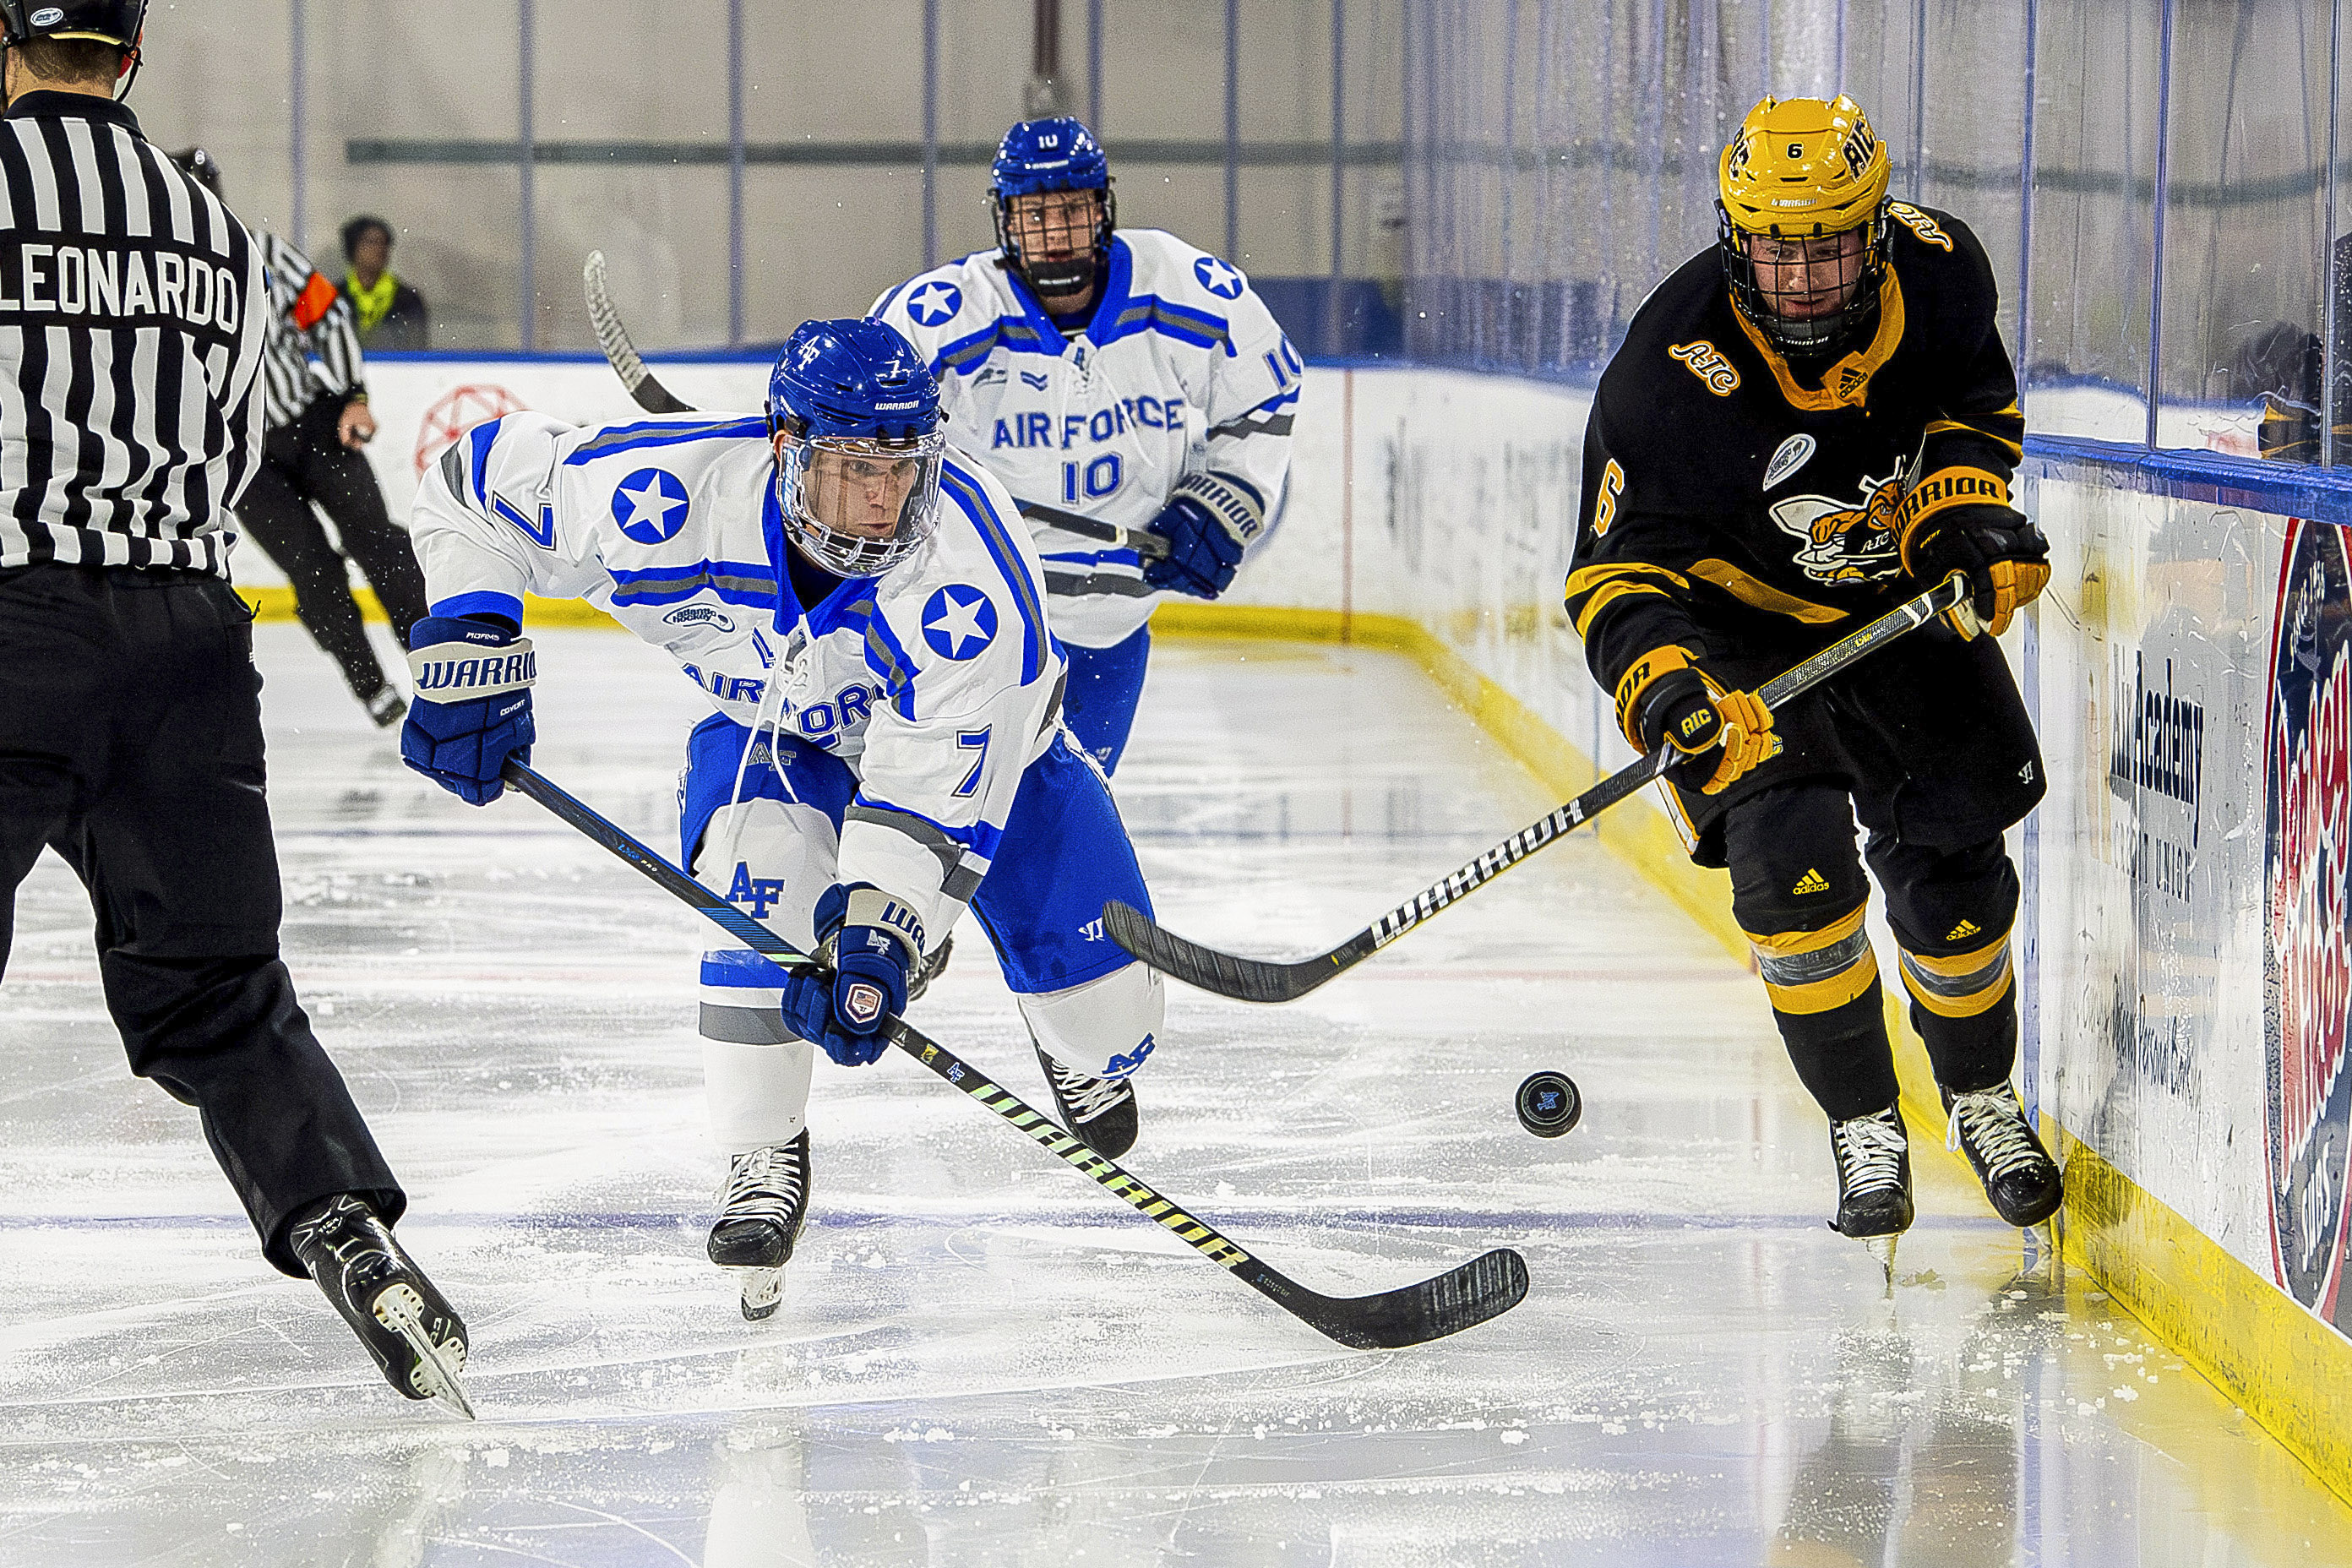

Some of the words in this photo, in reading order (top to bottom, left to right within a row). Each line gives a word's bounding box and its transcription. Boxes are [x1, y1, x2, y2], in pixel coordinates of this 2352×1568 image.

[1787, 143, 1804, 161] 6
[884, 359, 901, 378] 7
[1669, 340, 1741, 396] AIC
[874, 400, 919, 411] WARRIOR
[992, 411, 1053, 450] AIR
[1060, 394, 1184, 451] FORCE
[1061, 450, 1124, 505] 10
[1593, 457, 1625, 538] 6
[500, 700, 525, 716] COVERT
[1681, 709, 1712, 738] AIC
[950, 723, 993, 798] 7
[2133, 650, 2204, 850] Academy
[2273, 642, 2350, 955] Jersey
[725, 861, 786, 919] AF
[1370, 798, 1584, 949] WARRIOR
[1793, 882, 1830, 896] adidas
[2156, 836, 2191, 904] UNION
[947, 1062, 965, 1083] AF
[968, 1082, 1250, 1270] WARRIOR
[2301, 1141, 2331, 1272] SUBS
